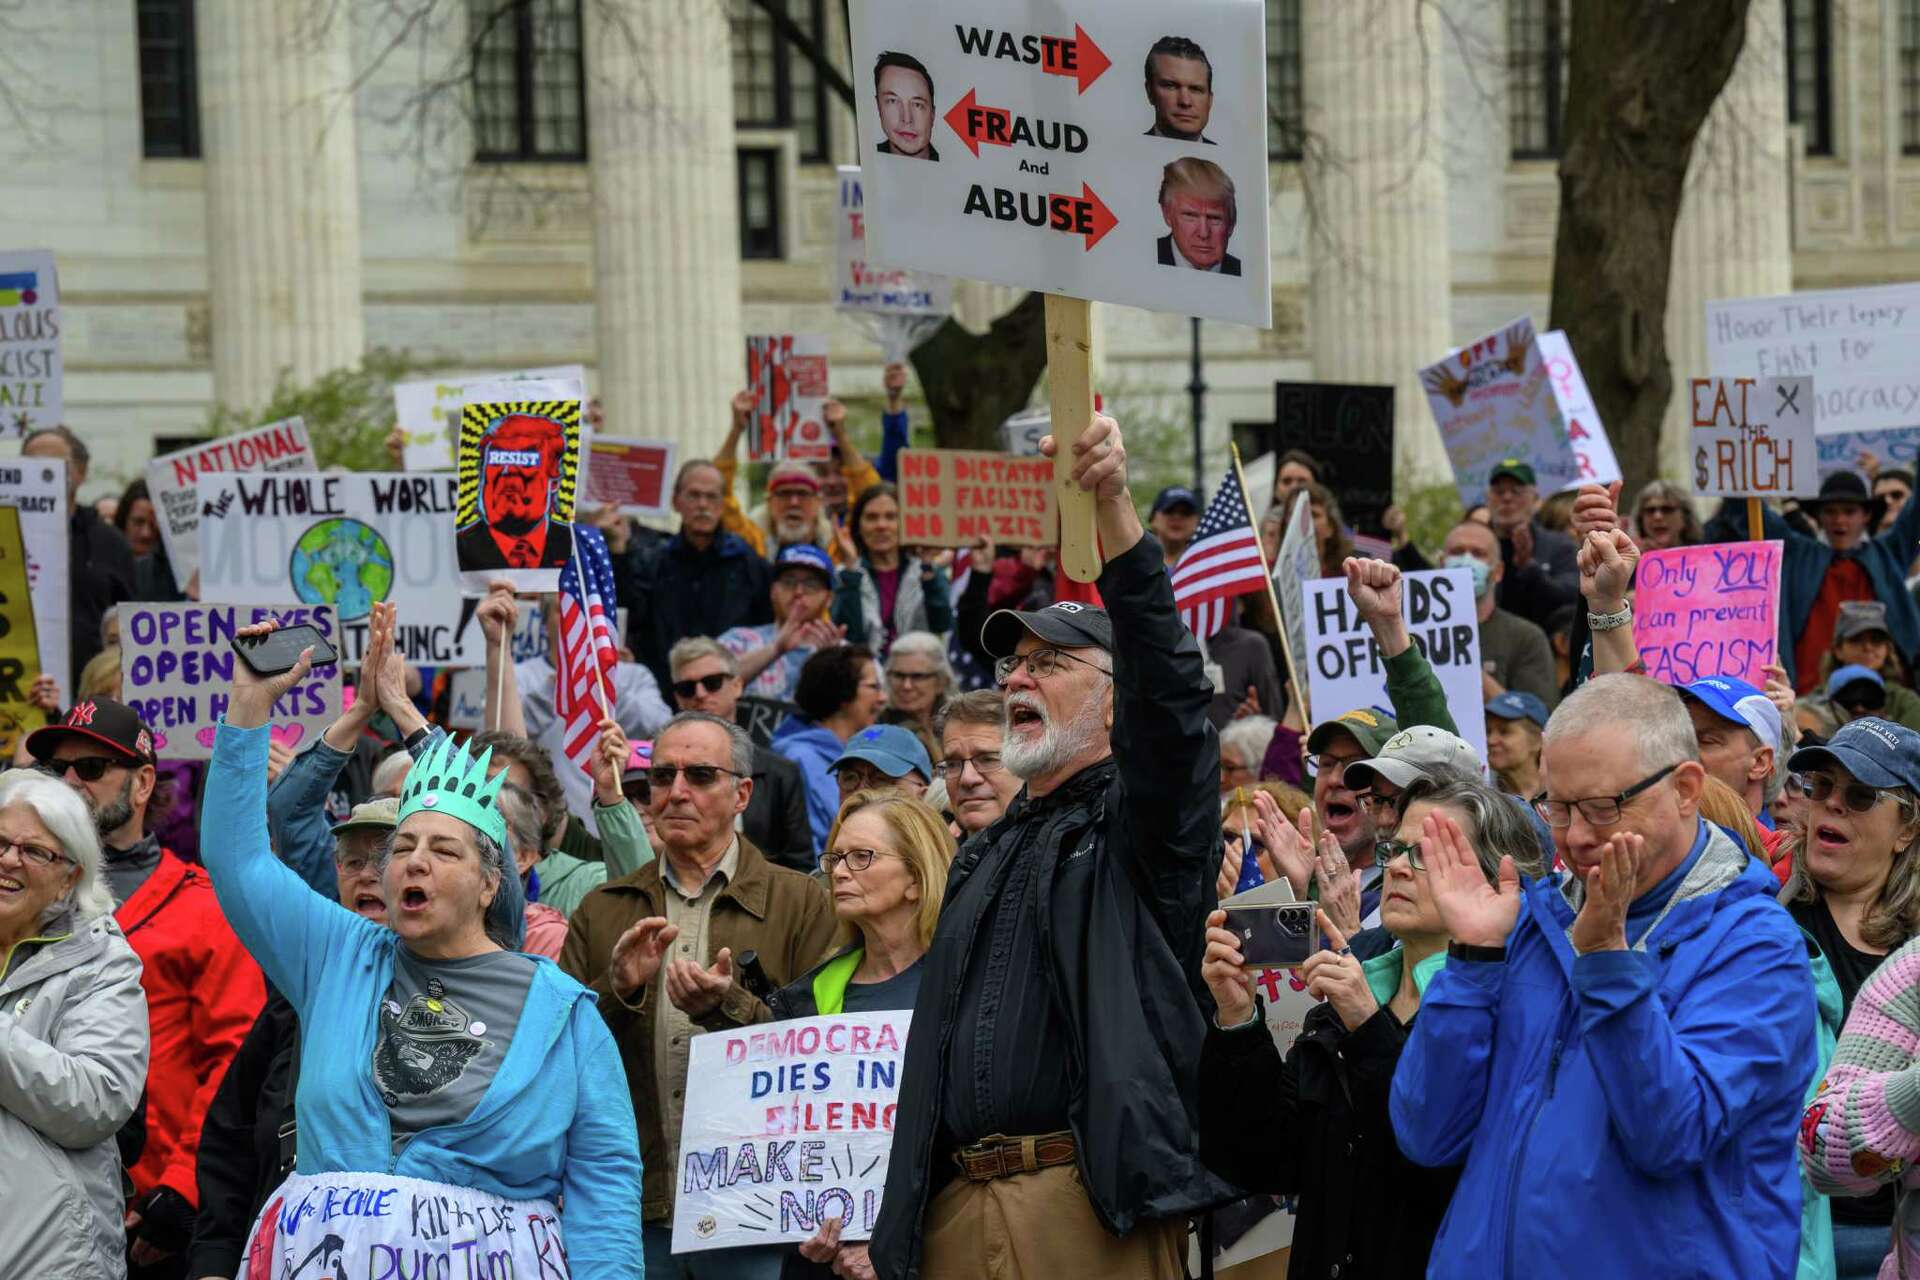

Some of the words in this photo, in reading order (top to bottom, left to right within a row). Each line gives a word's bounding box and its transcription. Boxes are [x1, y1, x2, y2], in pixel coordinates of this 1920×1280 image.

[955, 24, 1078, 70] WASTE
[967, 108, 1088, 153] FRAUD
[1018, 159, 1049, 175] And
[963, 184, 1094, 235] ABUSE
[1691, 378, 1756, 427] EAT
[1738, 423, 1769, 441] THE
[172, 421, 306, 488] NATIONAL
[489, 450, 539, 466] RESIST
[902, 454, 941, 480] NO
[203, 488, 234, 519] THE
[236, 477, 346, 517] WHOLE
[904, 482, 942, 509] NO
[903, 511, 944, 539] NO
[957, 513, 1043, 541] NAZIS
[1641, 555, 1698, 598] Only
[1711, 549, 1773, 592] YOU
[130, 606, 236, 646] OPEN
[1314, 576, 1455, 636] HDS
[1639, 611, 1677, 631] can
[1687, 599, 1770, 641] prevent
[130, 650, 235, 687] OPEN
[1639, 638, 1774, 685] FASCISM
[725, 1023, 901, 1065] DEMOCRA
[750, 1061, 832, 1100] DIES
[856, 1059, 897, 1090] IN
[683, 1140, 827, 1193] MAKE
